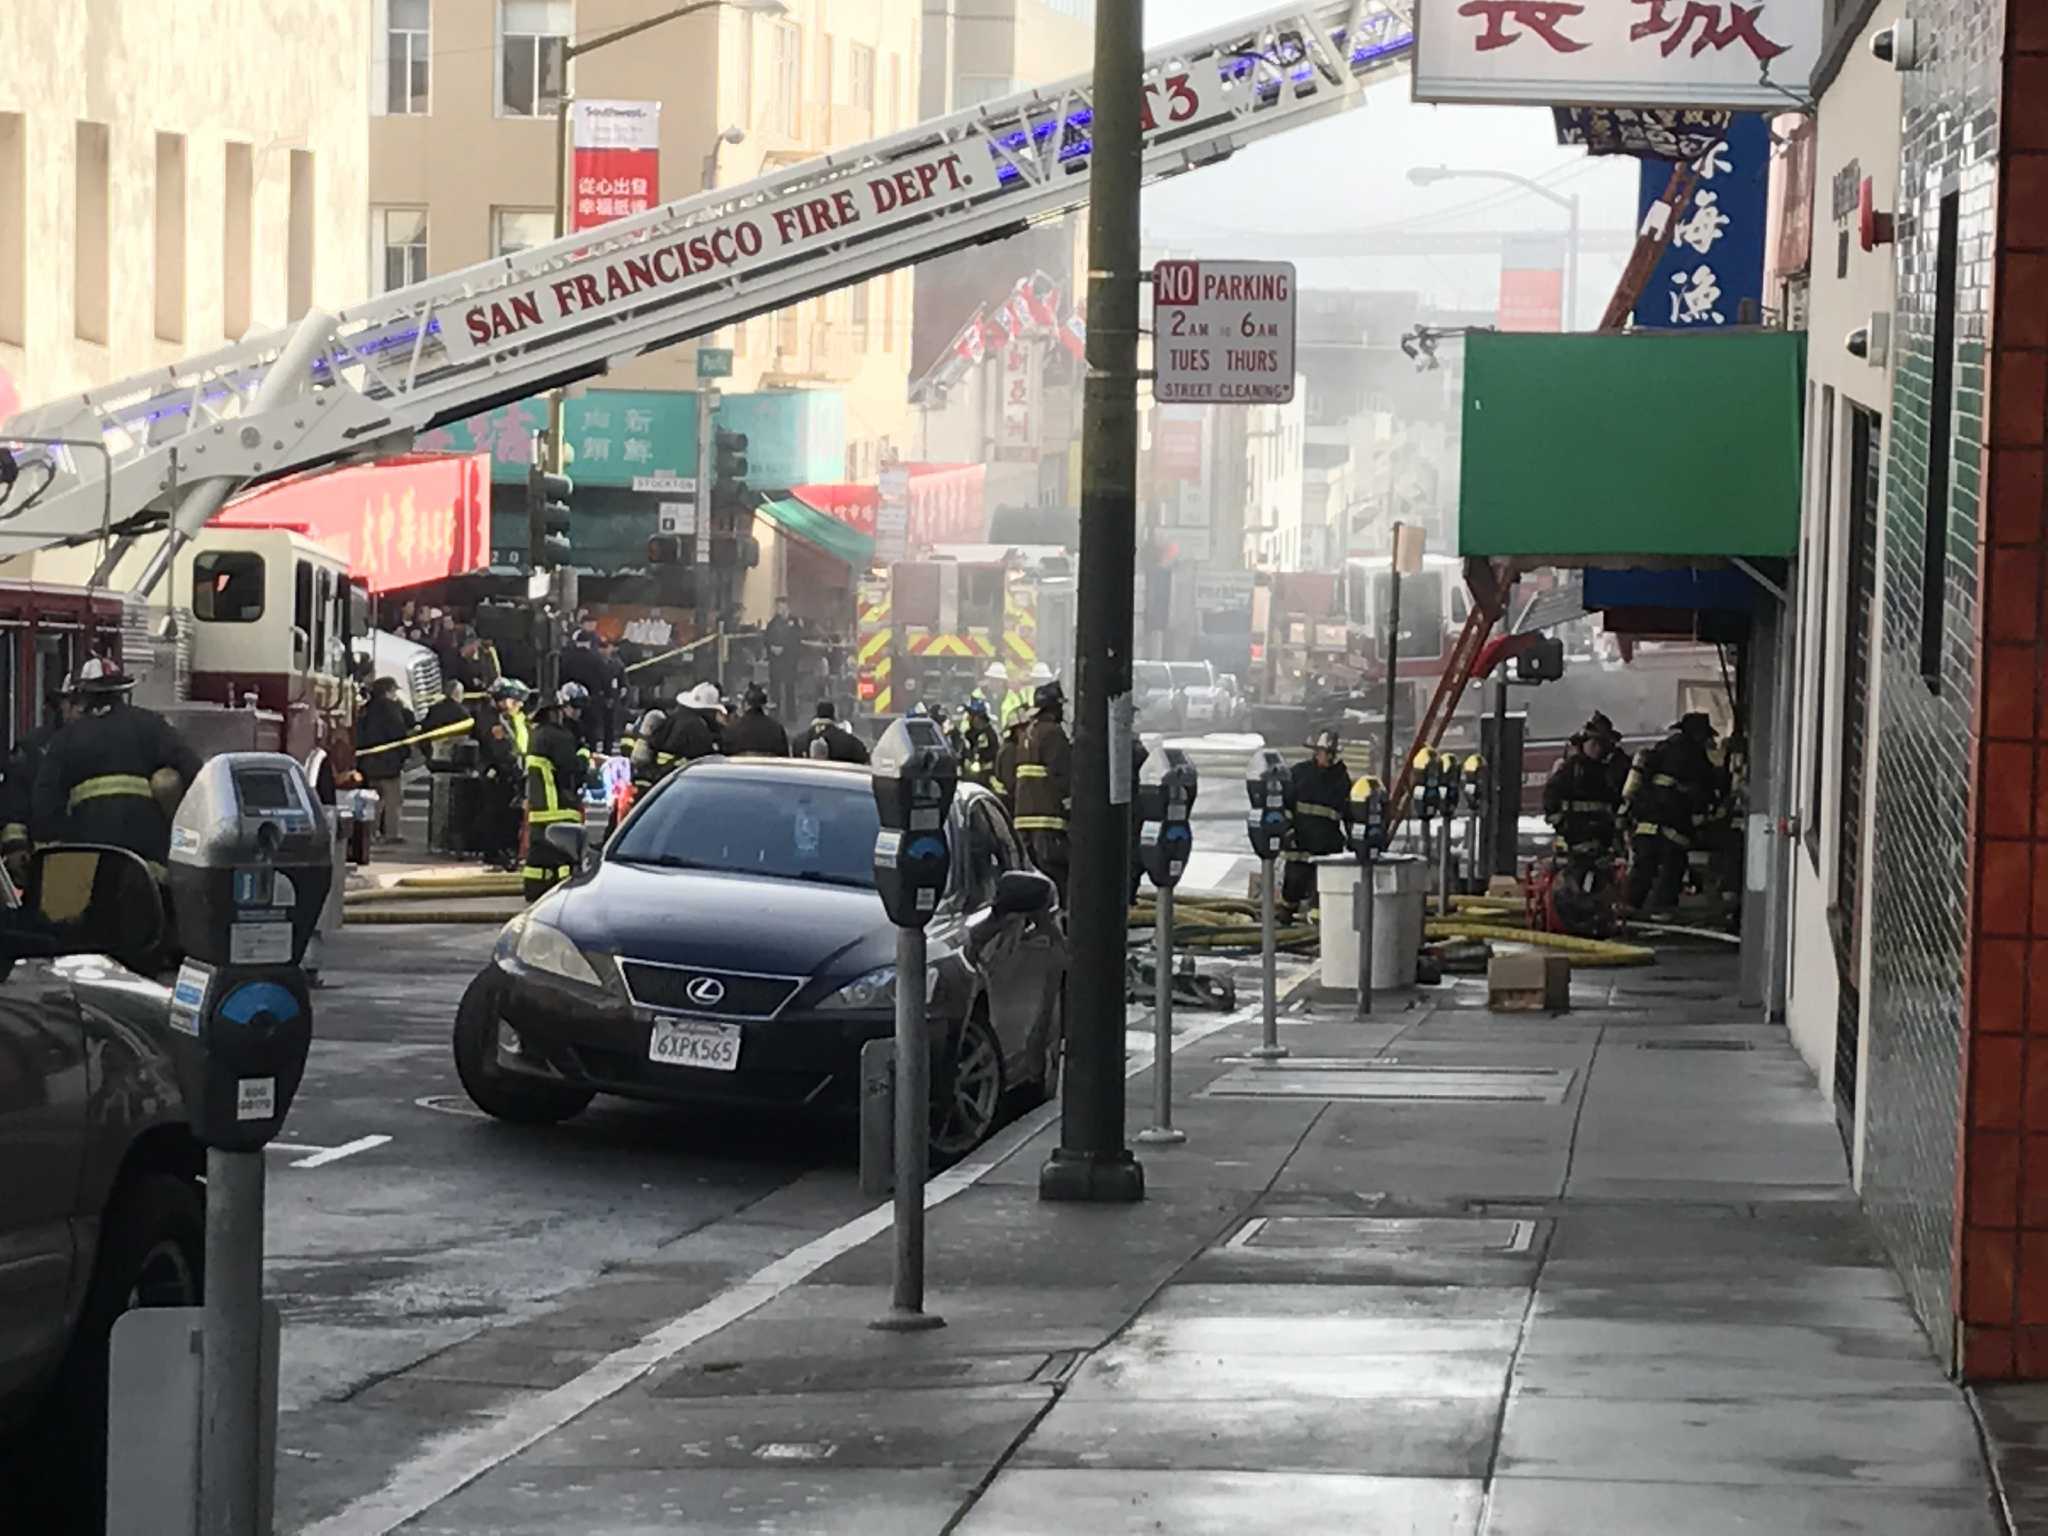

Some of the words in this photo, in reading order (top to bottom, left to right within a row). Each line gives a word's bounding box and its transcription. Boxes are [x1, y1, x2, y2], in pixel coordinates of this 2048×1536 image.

[465, 291, 544, 347] SAN
[551, 221, 763, 318] FRANCISCO
[771, 189, 861, 246] FIRE
[866, 152, 973, 214] DEPT.
[1159, 266, 1193, 300] NO
[1204, 275, 1288, 301] PARKING
[1170, 350, 1210, 371] TUES
[1226, 350, 1278, 372] THURS
[1165, 383, 1212, 397] STREET
[1219, 383, 1282, 398] CLEANING
[637, 479, 694, 489] STOCKTON
[658, 1036, 732, 1063] 6XPK565
